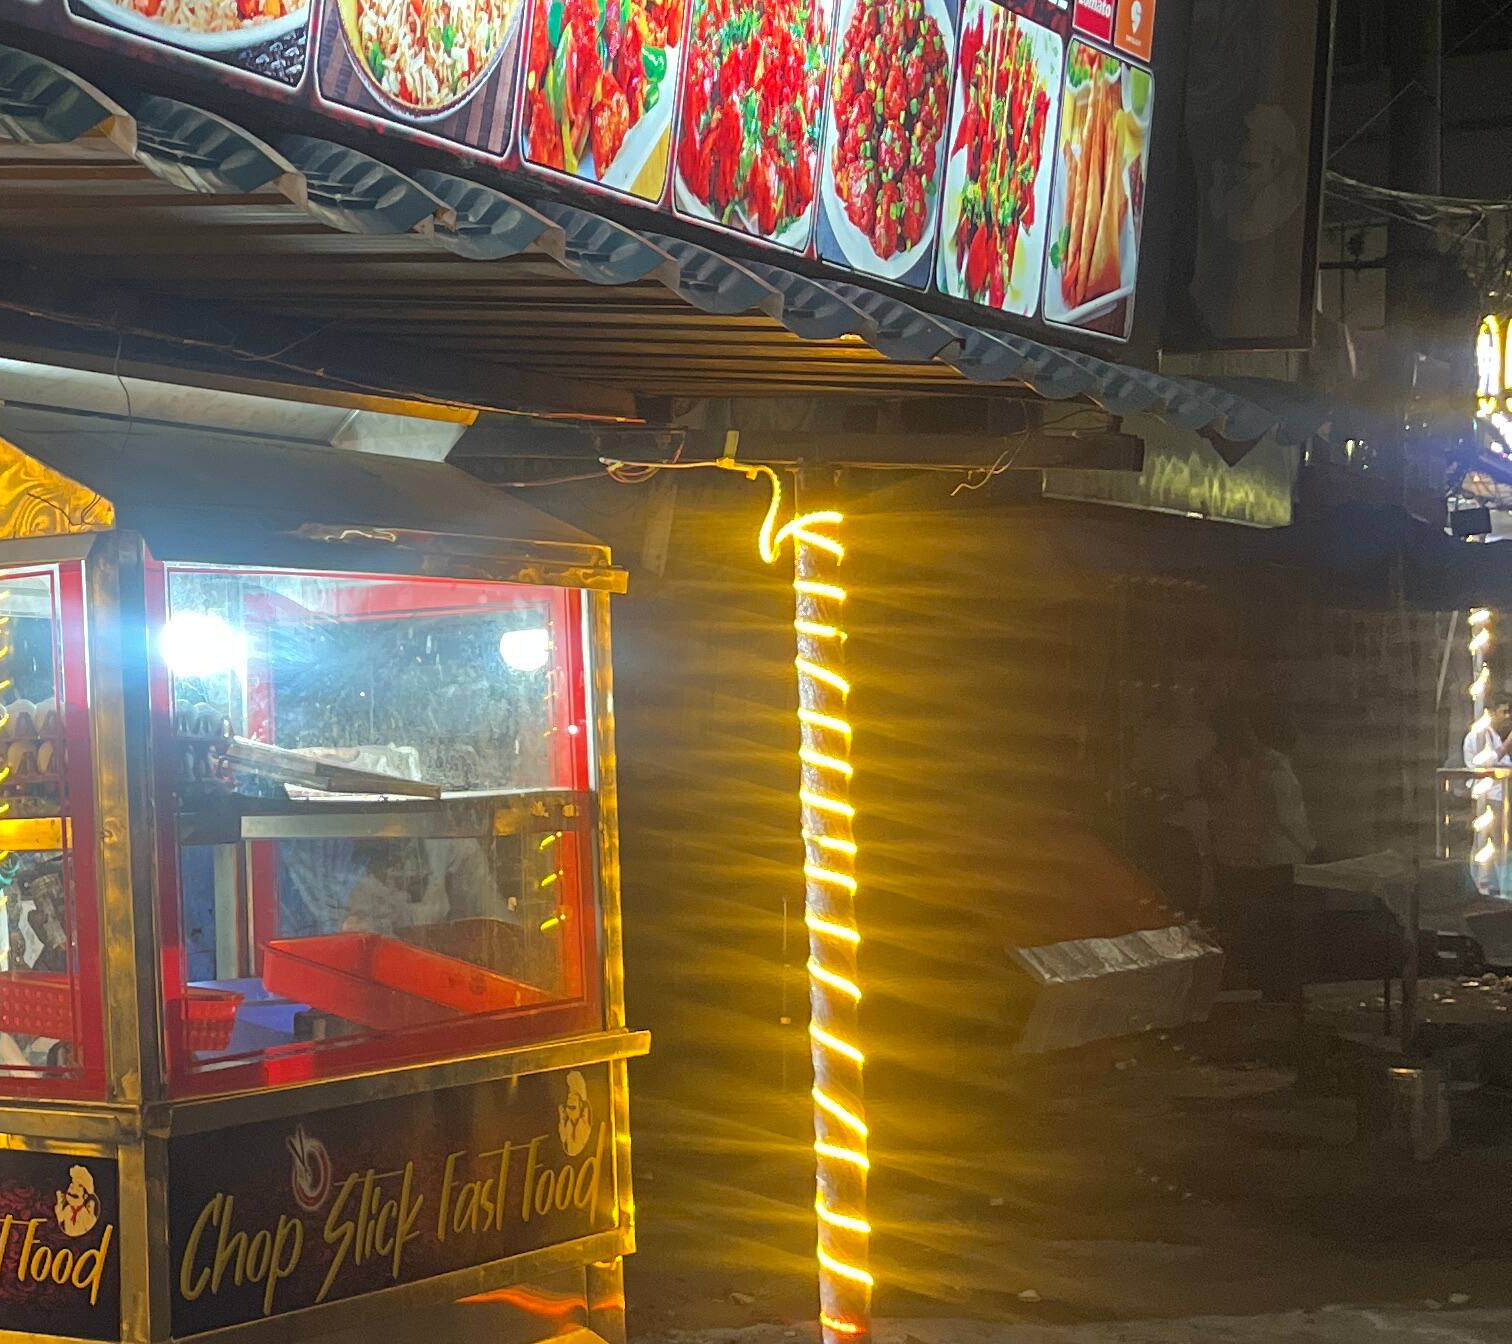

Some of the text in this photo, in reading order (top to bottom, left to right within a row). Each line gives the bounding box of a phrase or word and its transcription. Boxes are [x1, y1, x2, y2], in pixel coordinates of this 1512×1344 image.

[16, 1216, 114, 1307] Food
[180, 1121, 608, 1317] Chop Stick Fast Food
